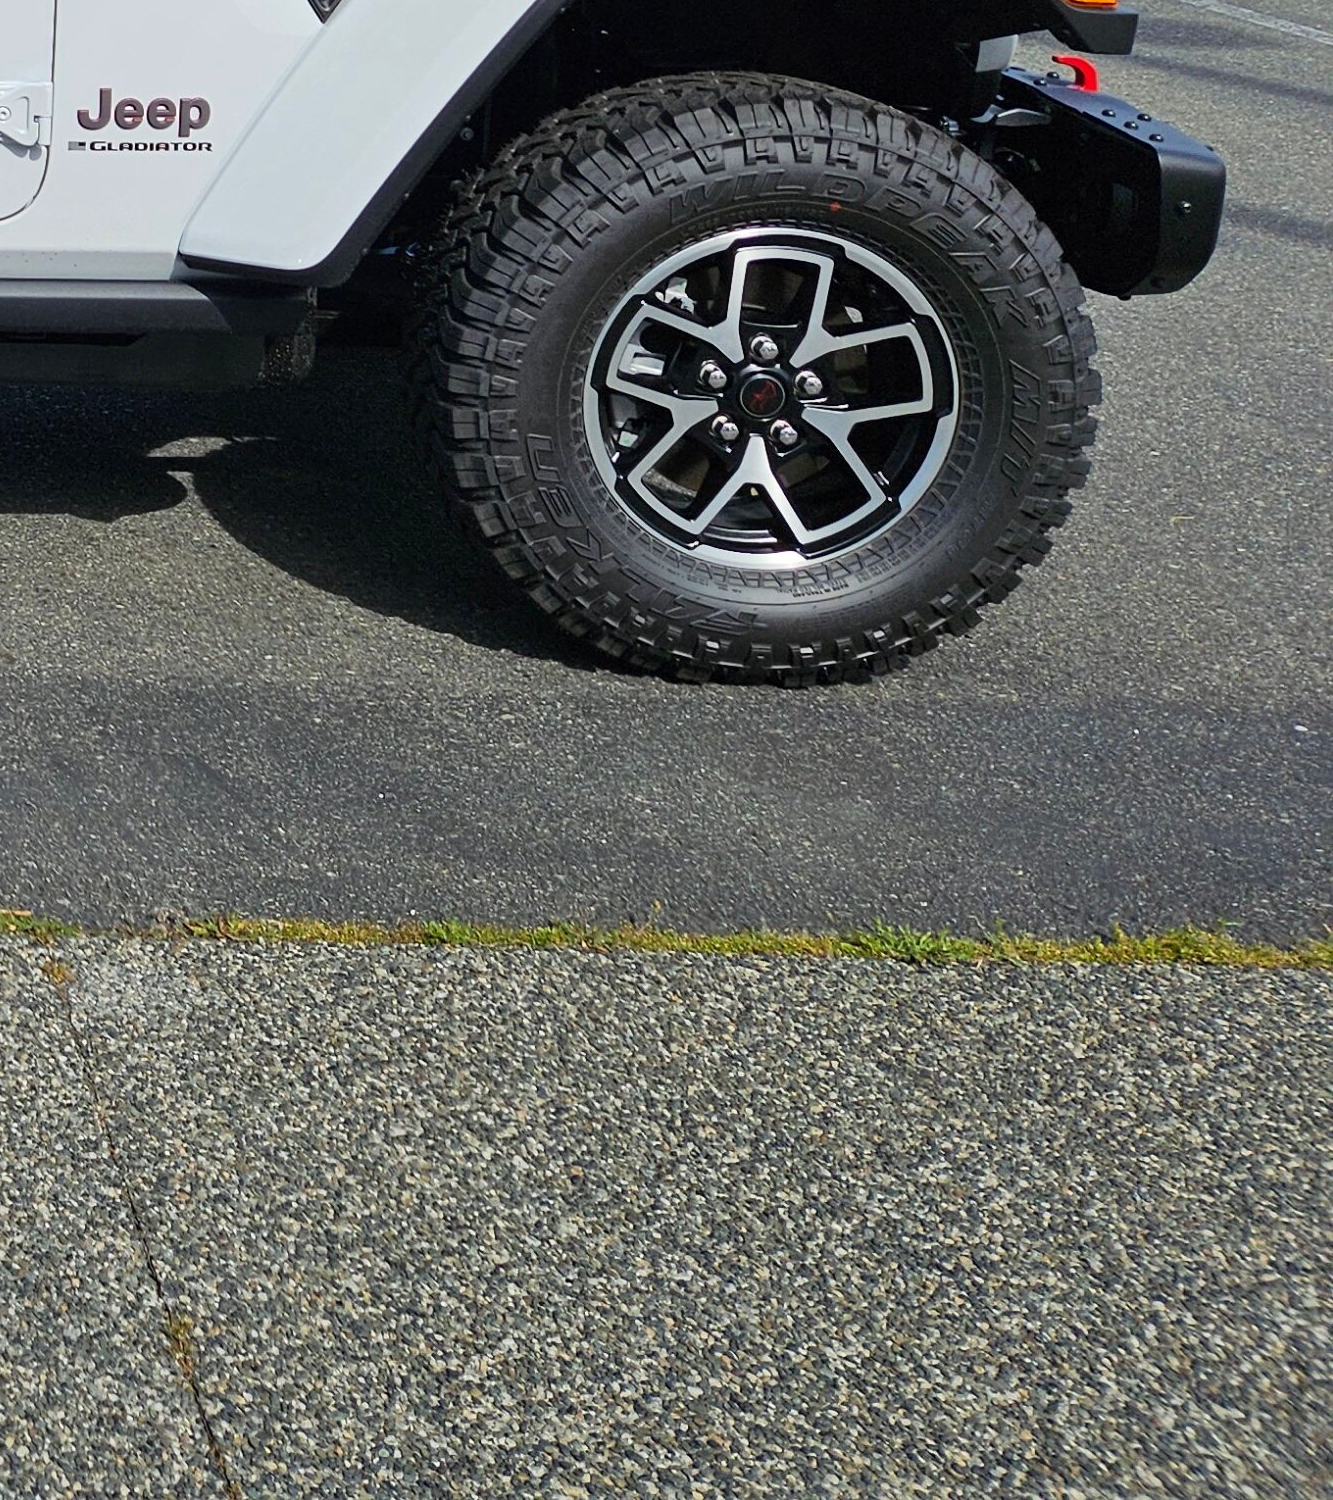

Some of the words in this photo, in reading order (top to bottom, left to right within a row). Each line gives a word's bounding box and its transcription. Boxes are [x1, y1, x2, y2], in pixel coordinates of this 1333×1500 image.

[77, 88, 211, 138] Jeep
[89, 140, 213, 152] GLADIATOR
[669, 168, 1029, 328] WILDPEAK
